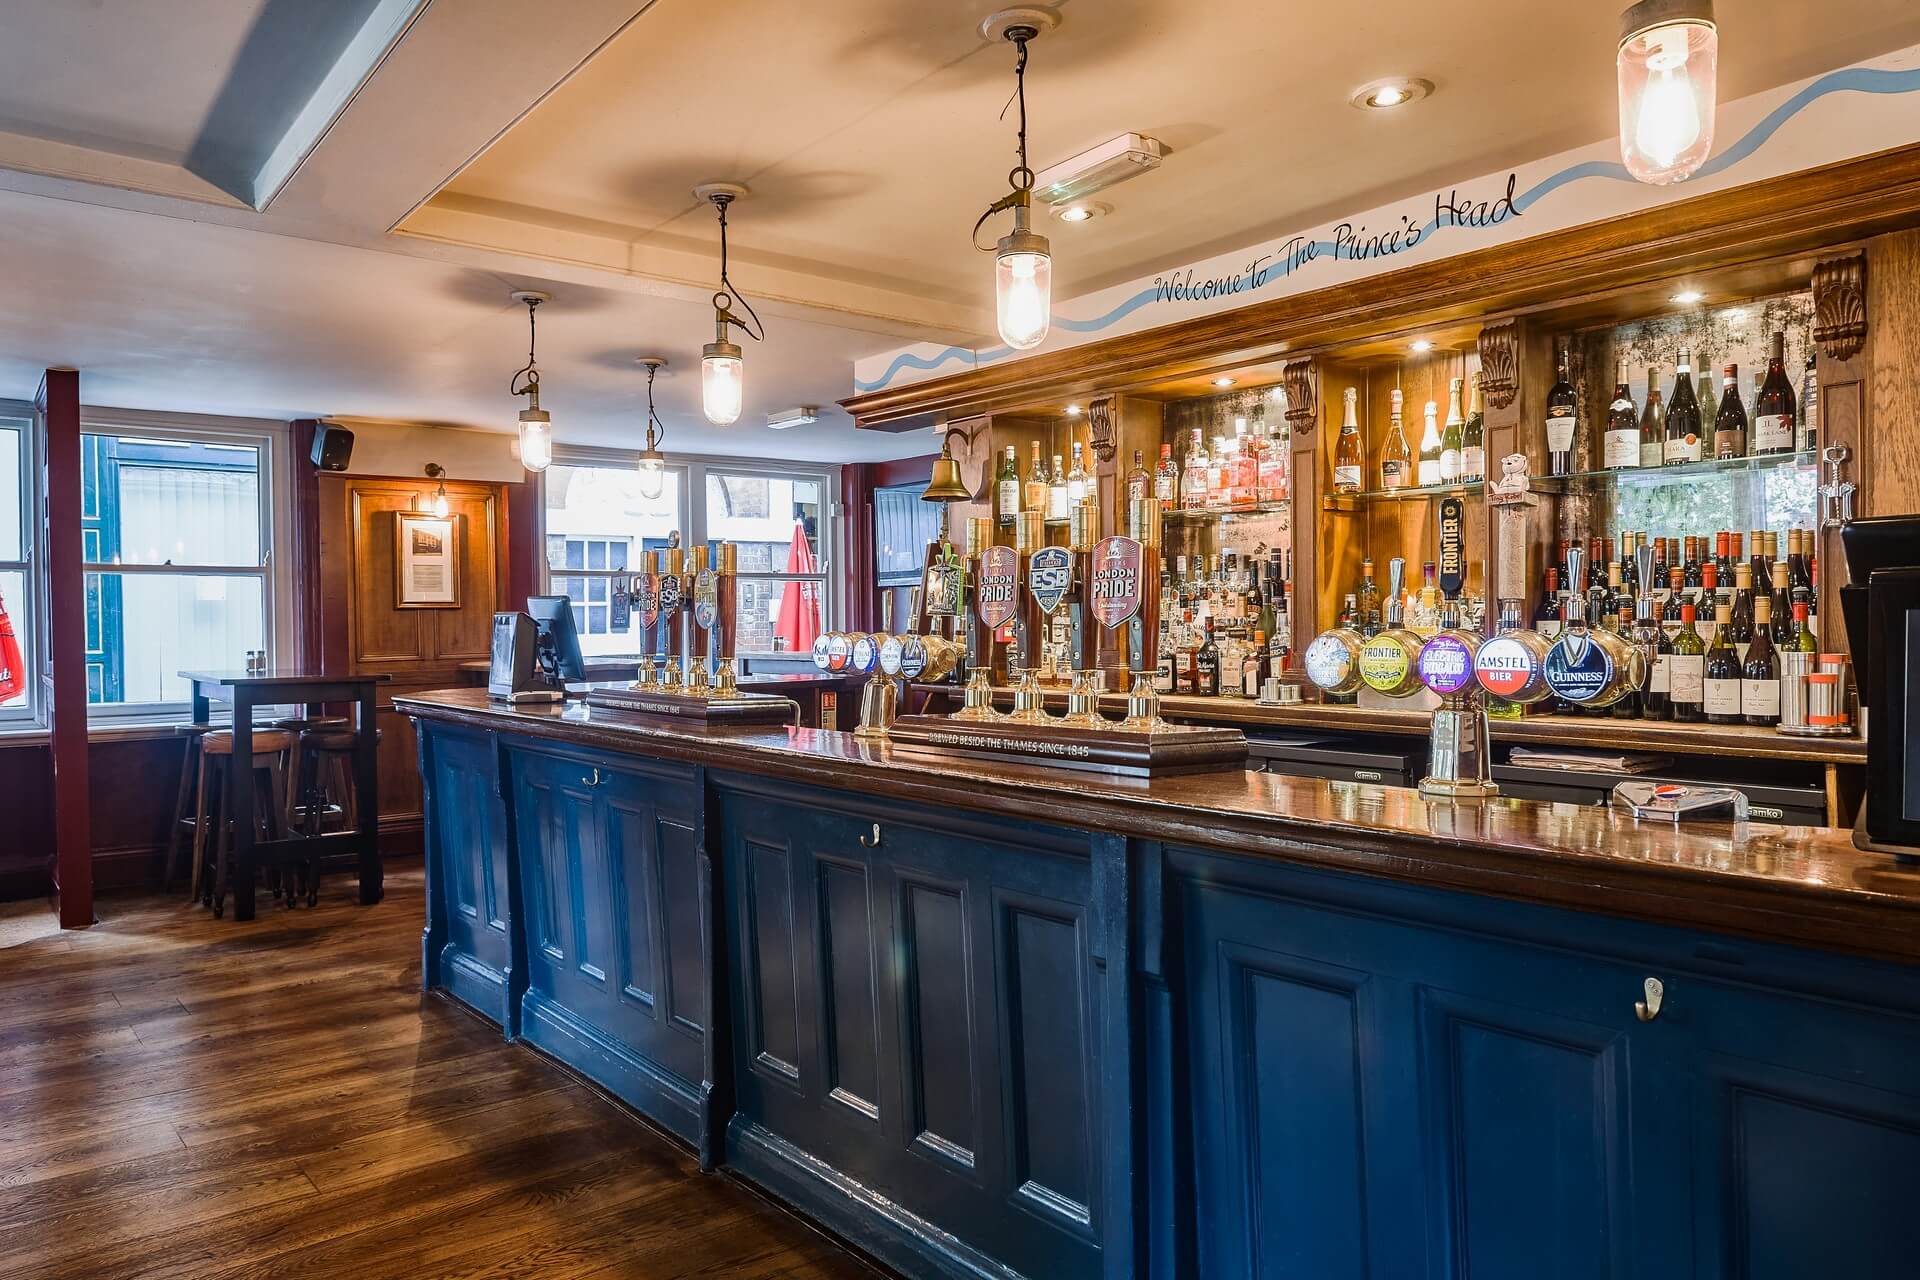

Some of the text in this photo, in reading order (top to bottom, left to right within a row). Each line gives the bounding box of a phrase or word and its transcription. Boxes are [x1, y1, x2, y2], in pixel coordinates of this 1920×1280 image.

[1154, 173, 1522, 303] Welcome to The Prince's Head
[1443, 518, 1458, 574] FRONTIER
[981, 575, 1013, 585] LONDON
[1031, 568, 1068, 590] ESB
[1094, 568, 1136, 579] LONDON
[661, 588, 678, 603] ESB
[981, 585, 1013, 602] PRIDE
[1093, 579, 1135, 598] PRIDE
[1364, 647, 1401, 658] FRONTIER
[1424, 650, 1466, 663] ELECTRIC
[1479, 657, 1527, 669] AMSTEL
[1489, 672, 1512, 681] BIER
[1551, 671, 1603, 682] GUINNESS
[928, 732, 1089, 757] BREWED BESIDE THE THAMES SINCE 1845
